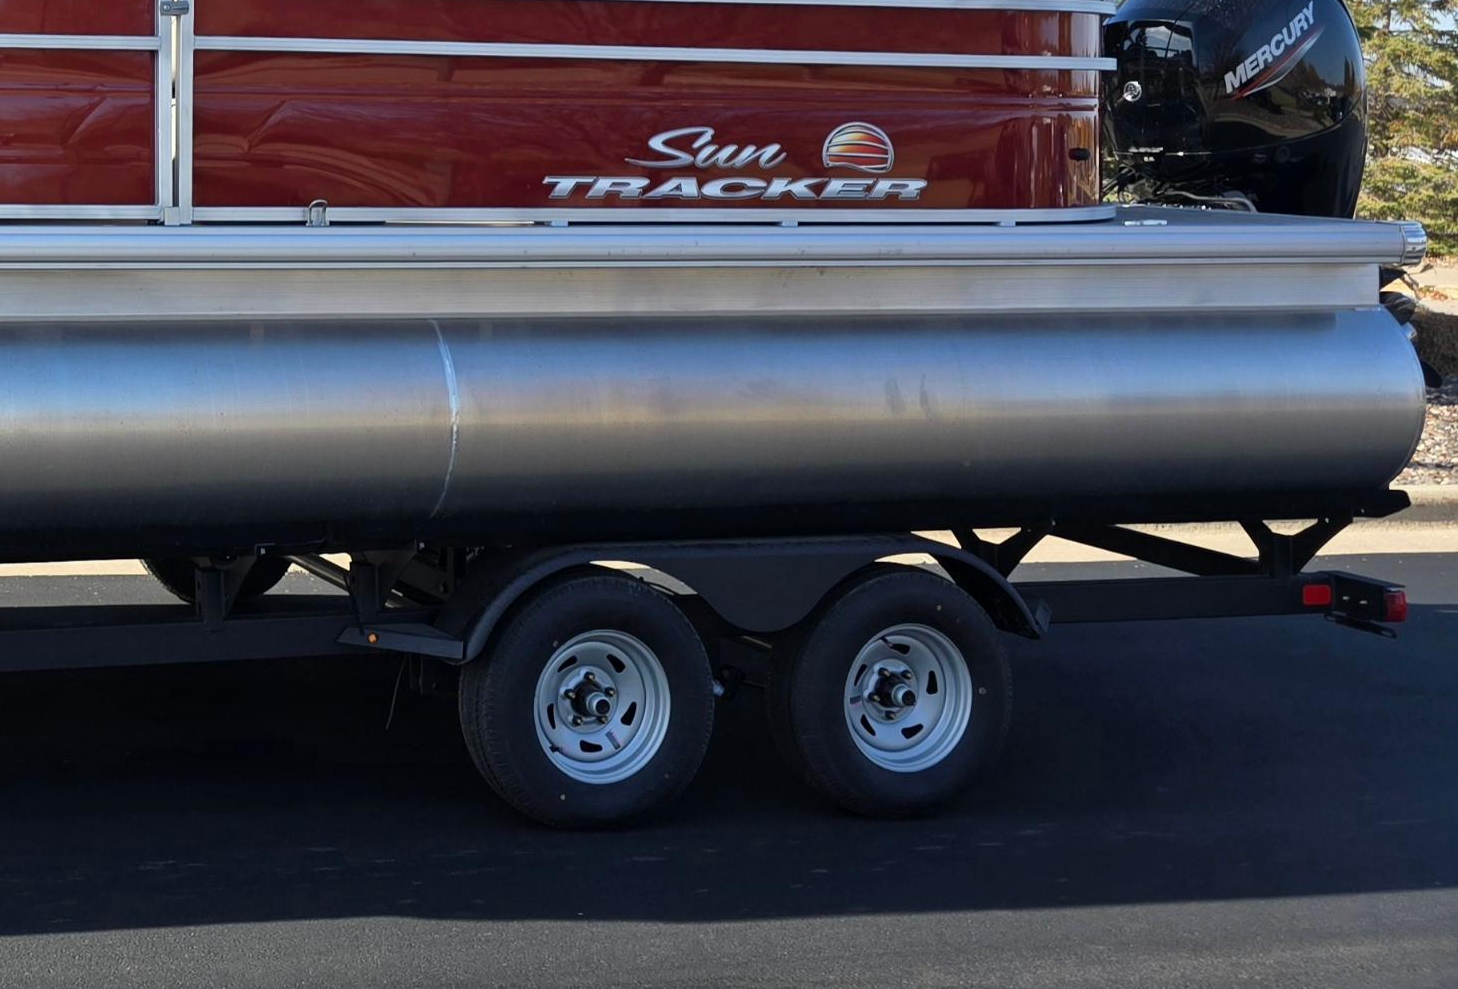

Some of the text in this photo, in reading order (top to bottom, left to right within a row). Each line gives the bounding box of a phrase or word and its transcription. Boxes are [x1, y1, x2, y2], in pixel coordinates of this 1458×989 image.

[1224, 0, 1315, 94] MERCURY
[624, 126, 788, 170] Sun
[542, 175, 928, 201] TRACKER
